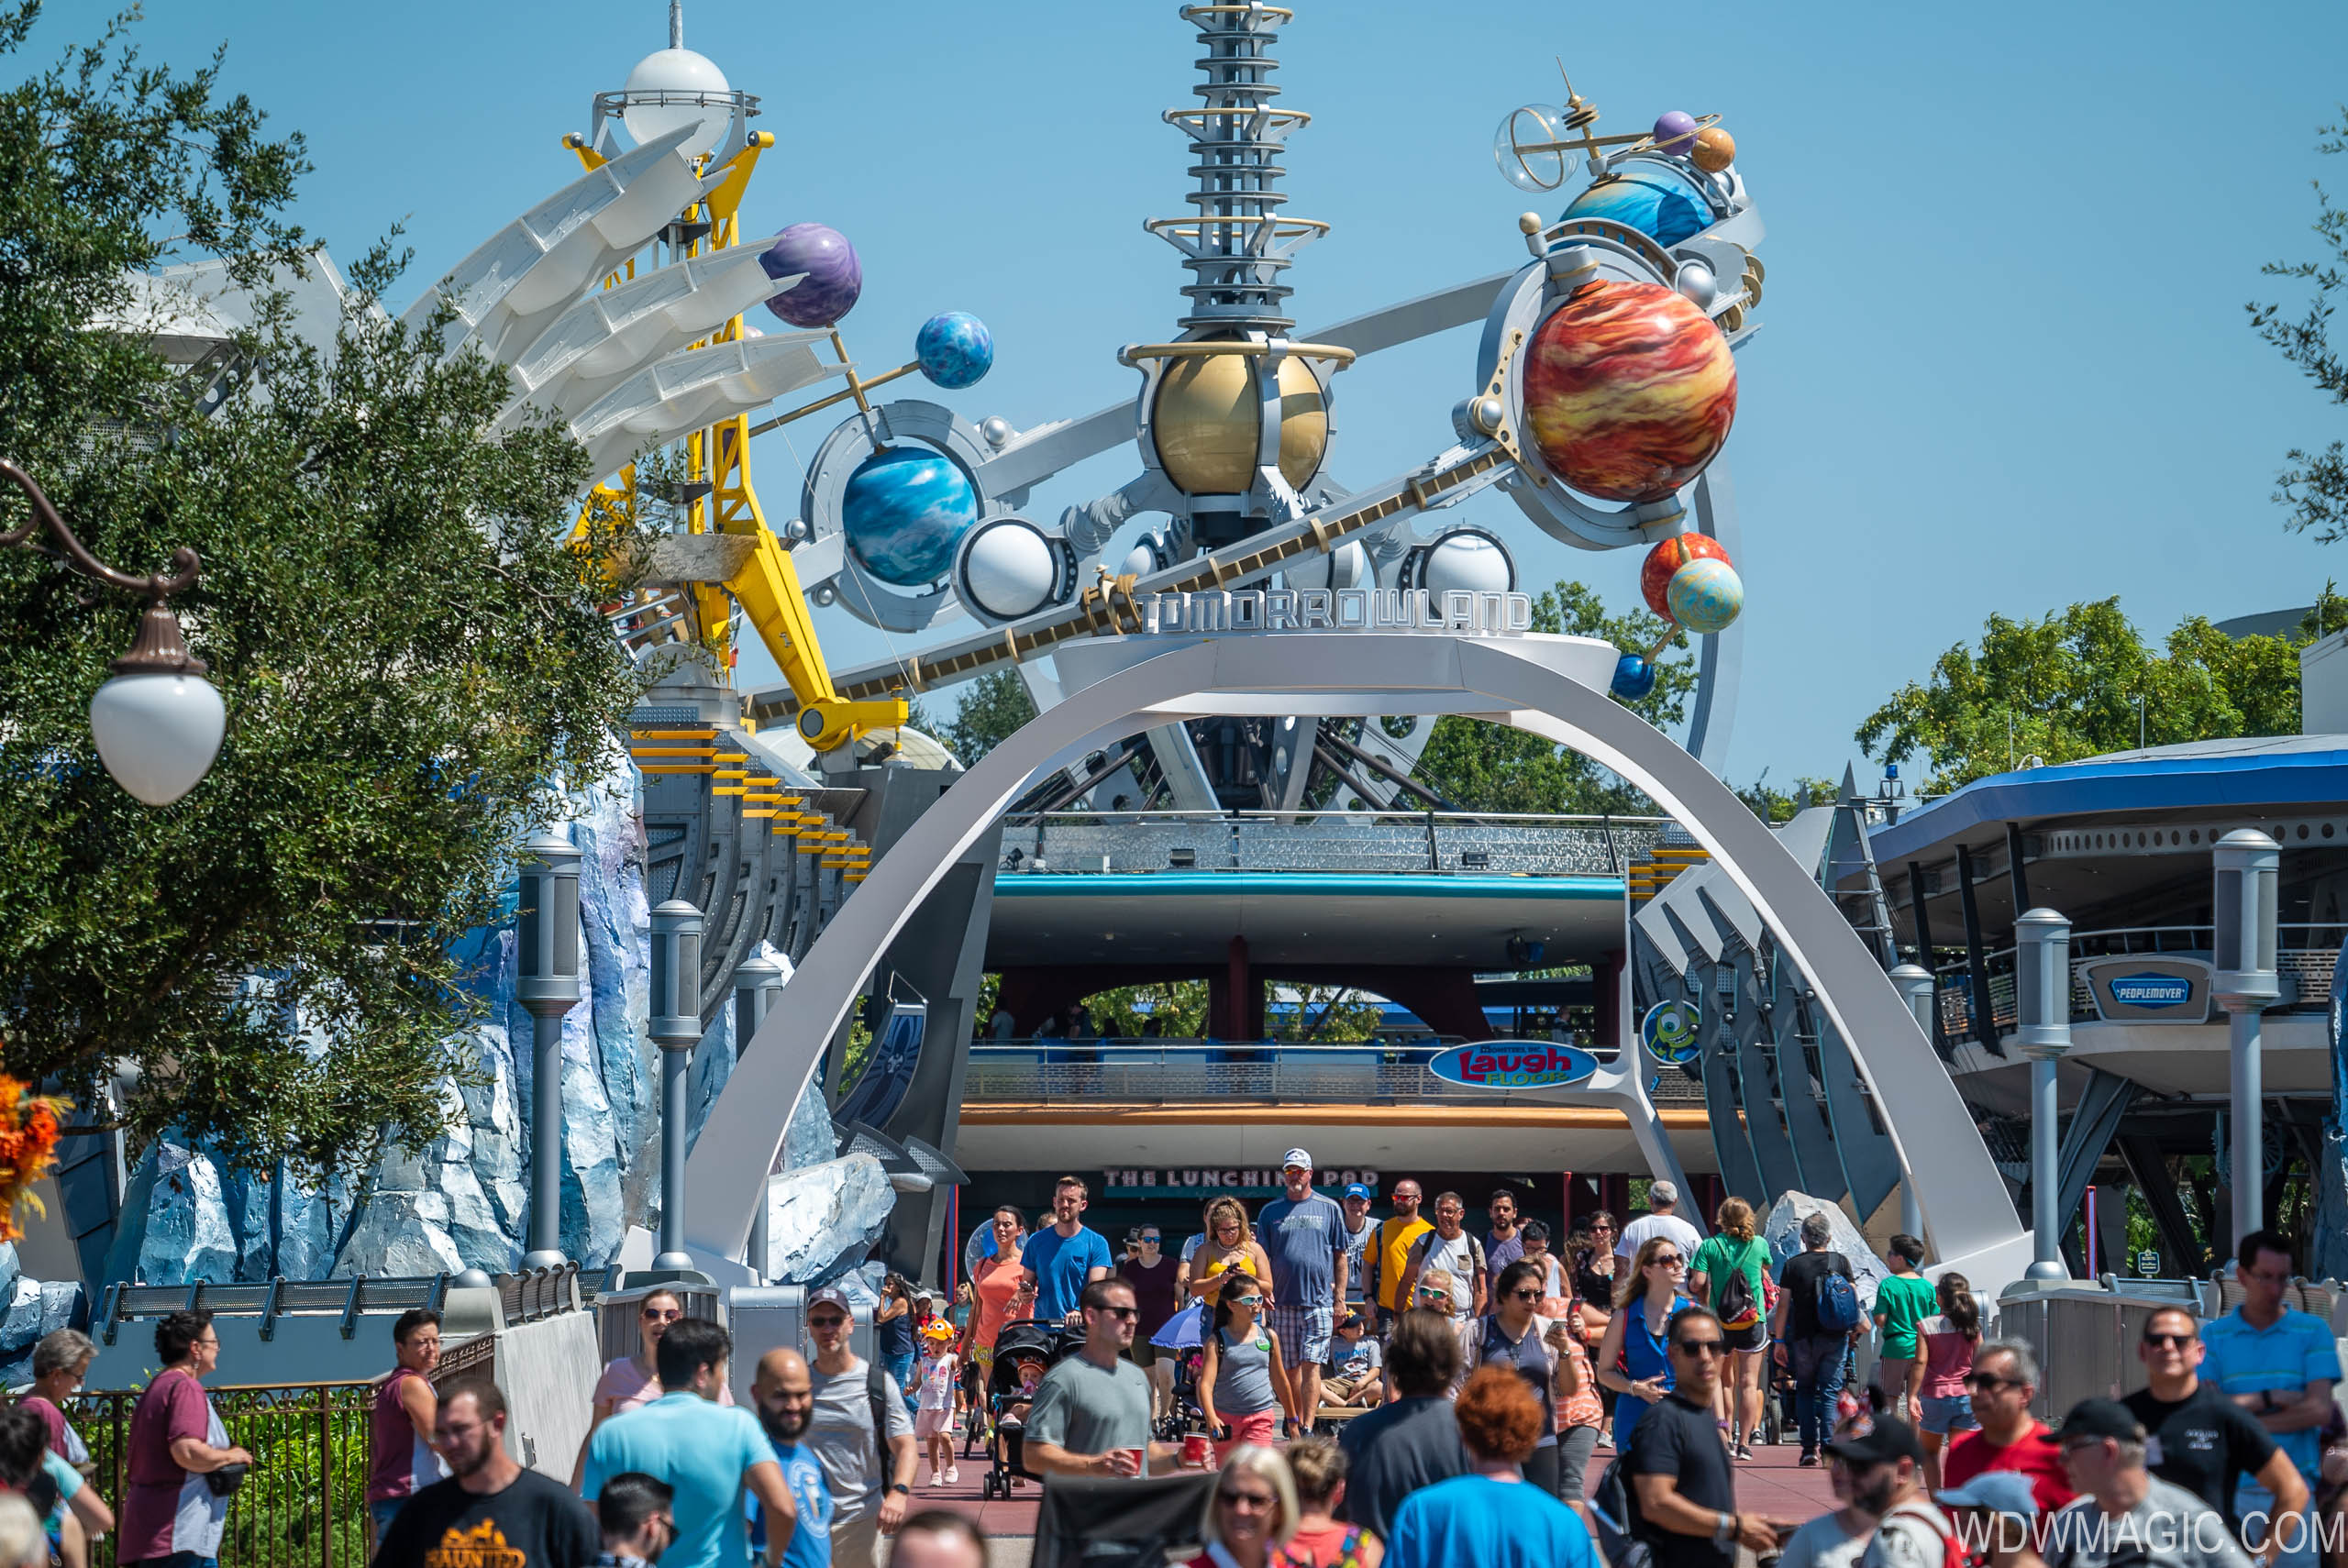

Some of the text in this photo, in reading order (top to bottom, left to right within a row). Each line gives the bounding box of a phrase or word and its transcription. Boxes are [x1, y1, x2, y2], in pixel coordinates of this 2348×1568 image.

[1136, 588, 1532, 634] TOMORROWLAND
[2120, 988, 2182, 999] PEOPLEMOVER
[1458, 1047, 1572, 1082] Laugh
[1486, 1072, 1570, 1087] FLOOR
[1103, 1170, 1379, 1187] THE LUNCHIN PAD
